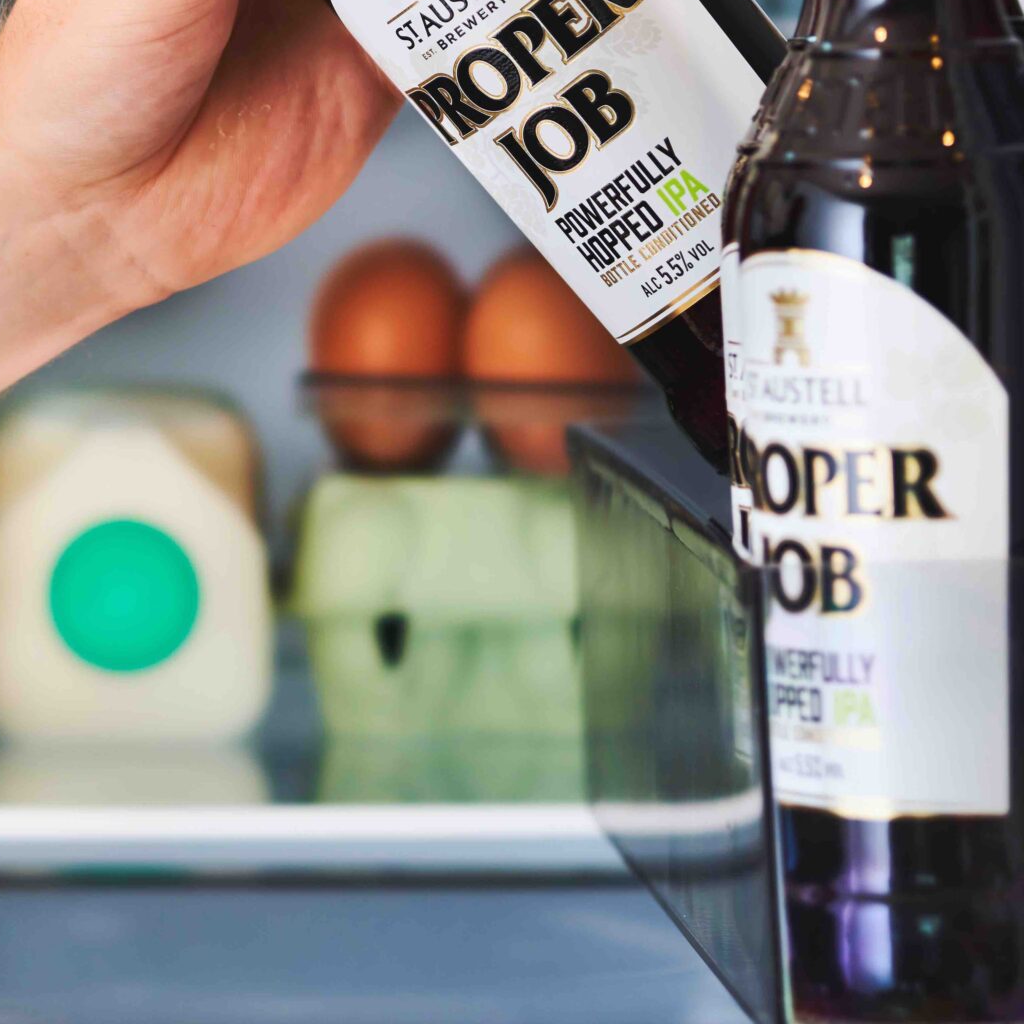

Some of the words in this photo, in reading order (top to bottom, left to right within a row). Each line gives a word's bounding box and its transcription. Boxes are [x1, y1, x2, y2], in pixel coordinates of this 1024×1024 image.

[422, 48, 437, 61] EST.
[493, 69, 637, 213] JOB
[554, 137, 682, 244] POWERFULLY
[576, 200, 664, 273] HOPPED
[656, 168, 710, 217] IPA
[600, 254, 641, 288] BOTTLE
[638, 192, 721, 261] CONDITIONED
[640, 277, 662, 298] ALC
[658, 250, 694, 285] 5.5%
[688, 239, 715, 262] VOL
